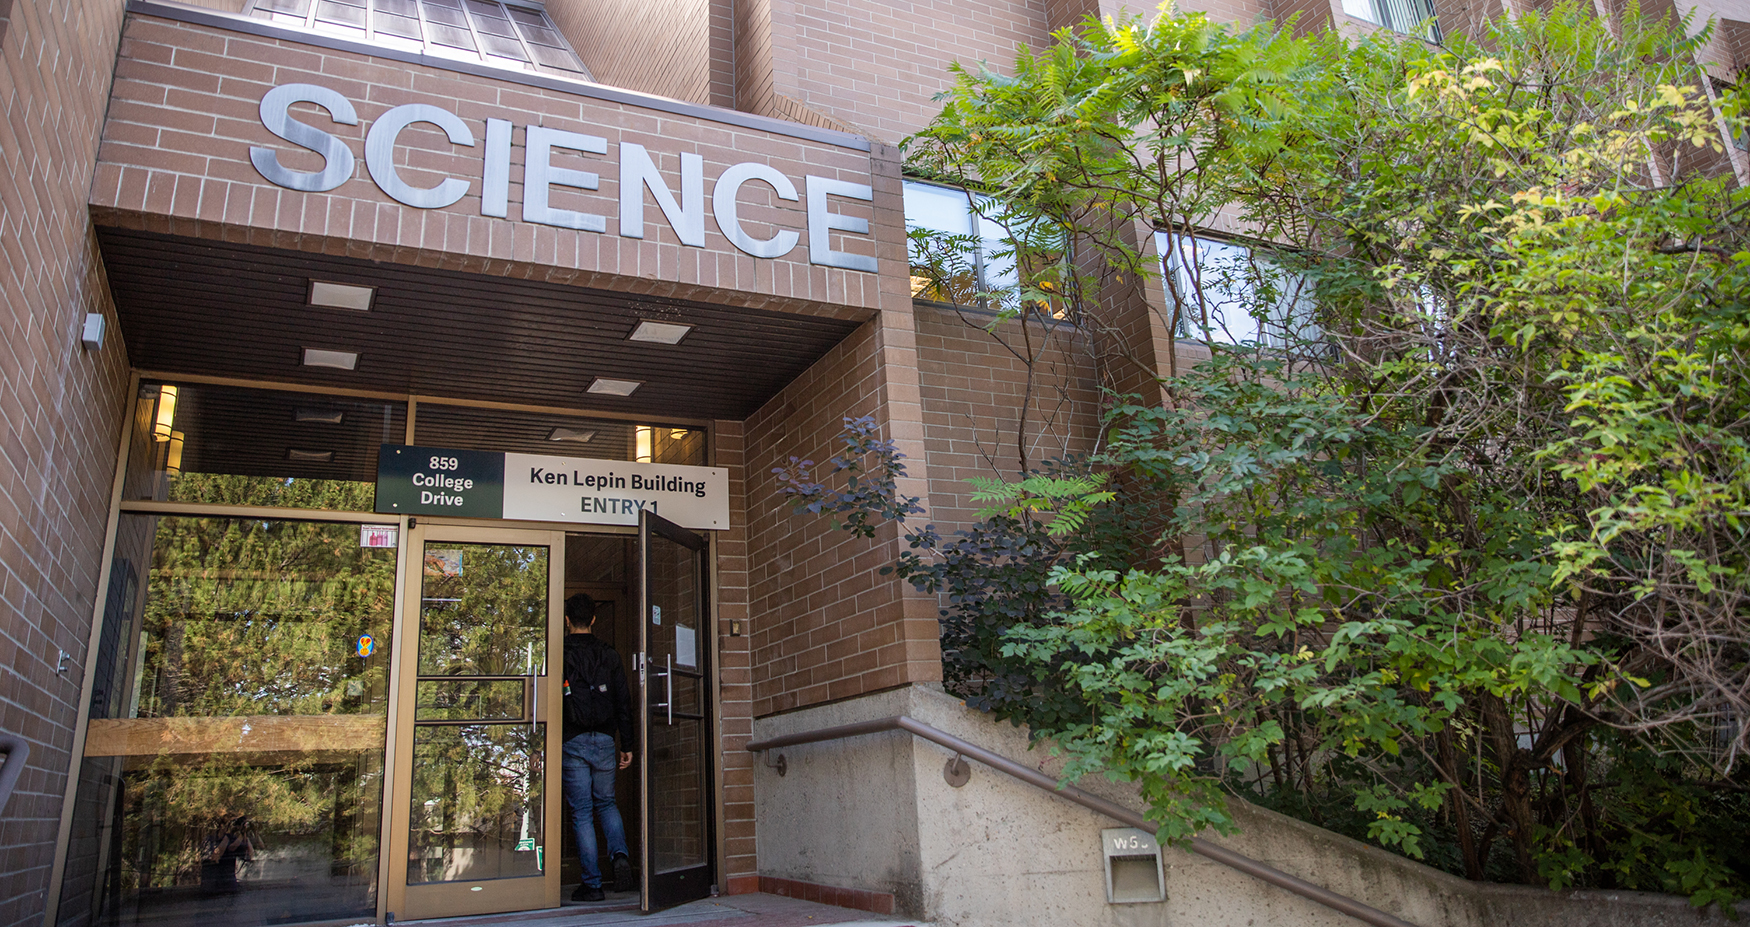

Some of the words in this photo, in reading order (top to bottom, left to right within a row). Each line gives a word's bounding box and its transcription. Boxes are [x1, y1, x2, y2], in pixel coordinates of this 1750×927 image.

[250, 83, 878, 272] SCIENCE
[429, 456, 459, 471] 859
[412, 472, 474, 492] College
[530, 467, 567, 485] Ken
[574, 470, 625, 491] Lepin
[631, 474, 706, 498] Building
[420, 490, 464, 507] Drive
[581, 496, 646, 515] ENTRY
[650, 500, 658, 515] 1
